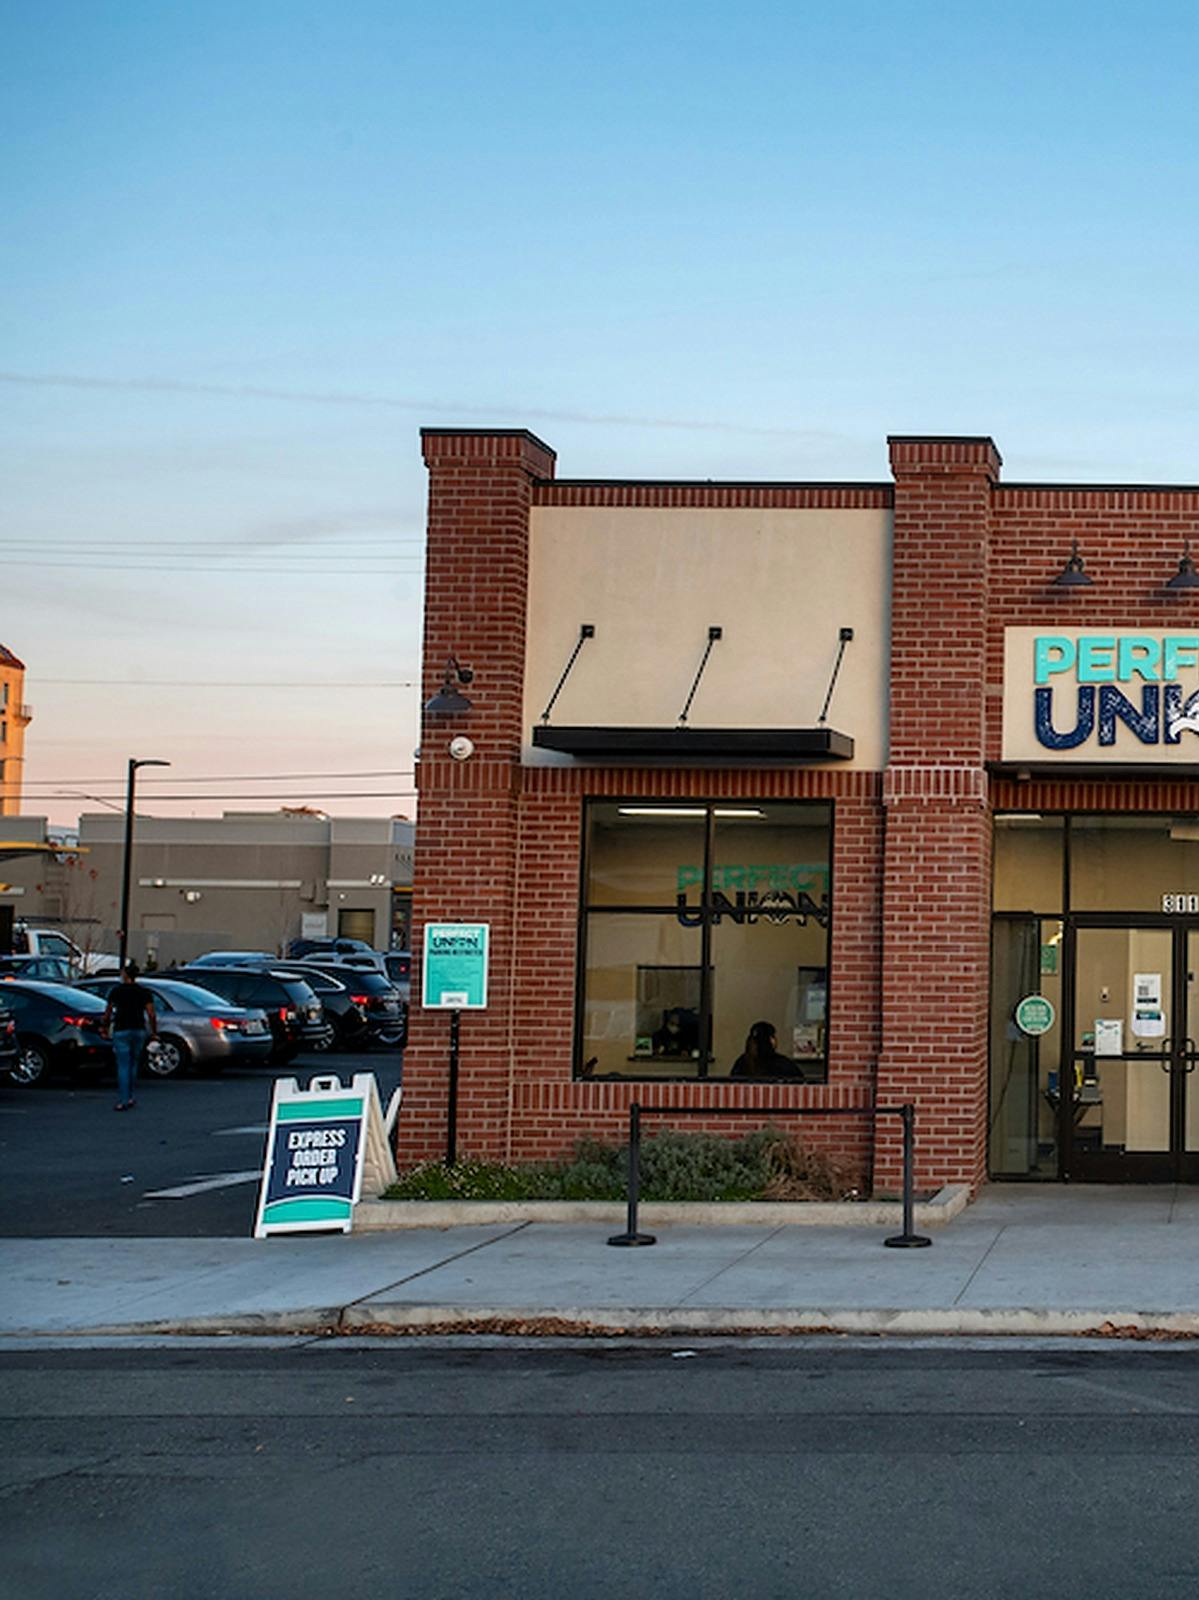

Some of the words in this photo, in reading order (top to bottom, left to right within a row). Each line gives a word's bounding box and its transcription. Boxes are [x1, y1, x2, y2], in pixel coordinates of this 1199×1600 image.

[288, 1129, 346, 1150] EXPRESS
[293, 1149, 336, 1168] ORDER
[286, 1168, 319, 1186] PICK
[319, 1166, 339, 1184] UP
